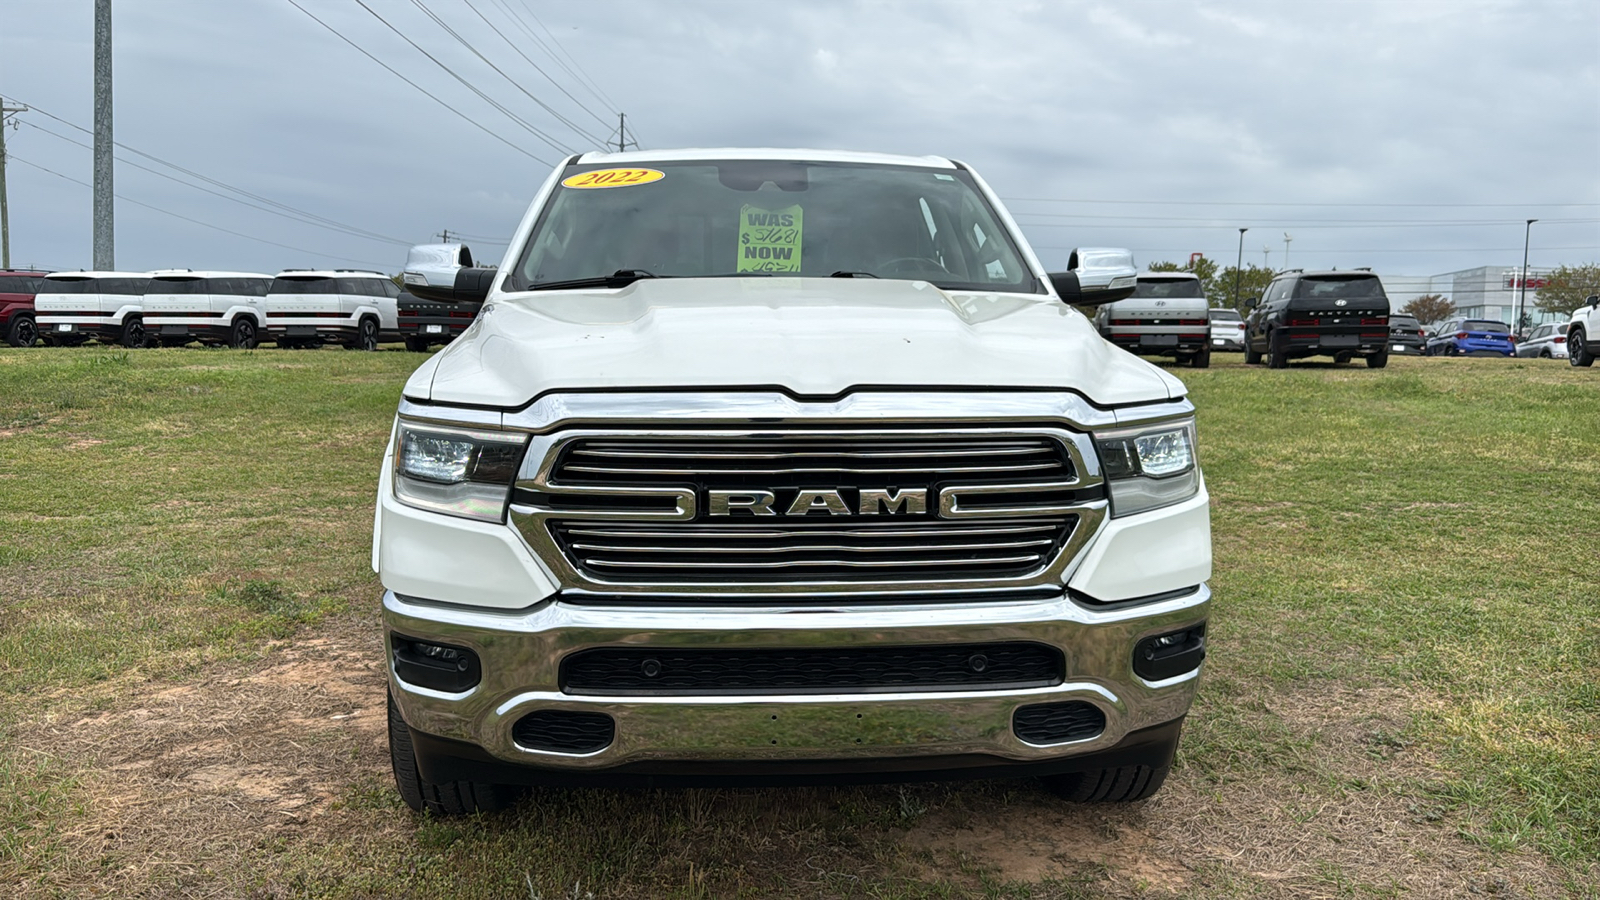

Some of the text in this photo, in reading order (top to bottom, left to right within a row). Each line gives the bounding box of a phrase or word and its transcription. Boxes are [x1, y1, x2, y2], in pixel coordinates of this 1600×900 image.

[575, 170, 649, 186] 2022
[747, 213, 794, 228] WAS
[744, 246, 794, 260] NOW
[708, 488, 928, 516] RAM
